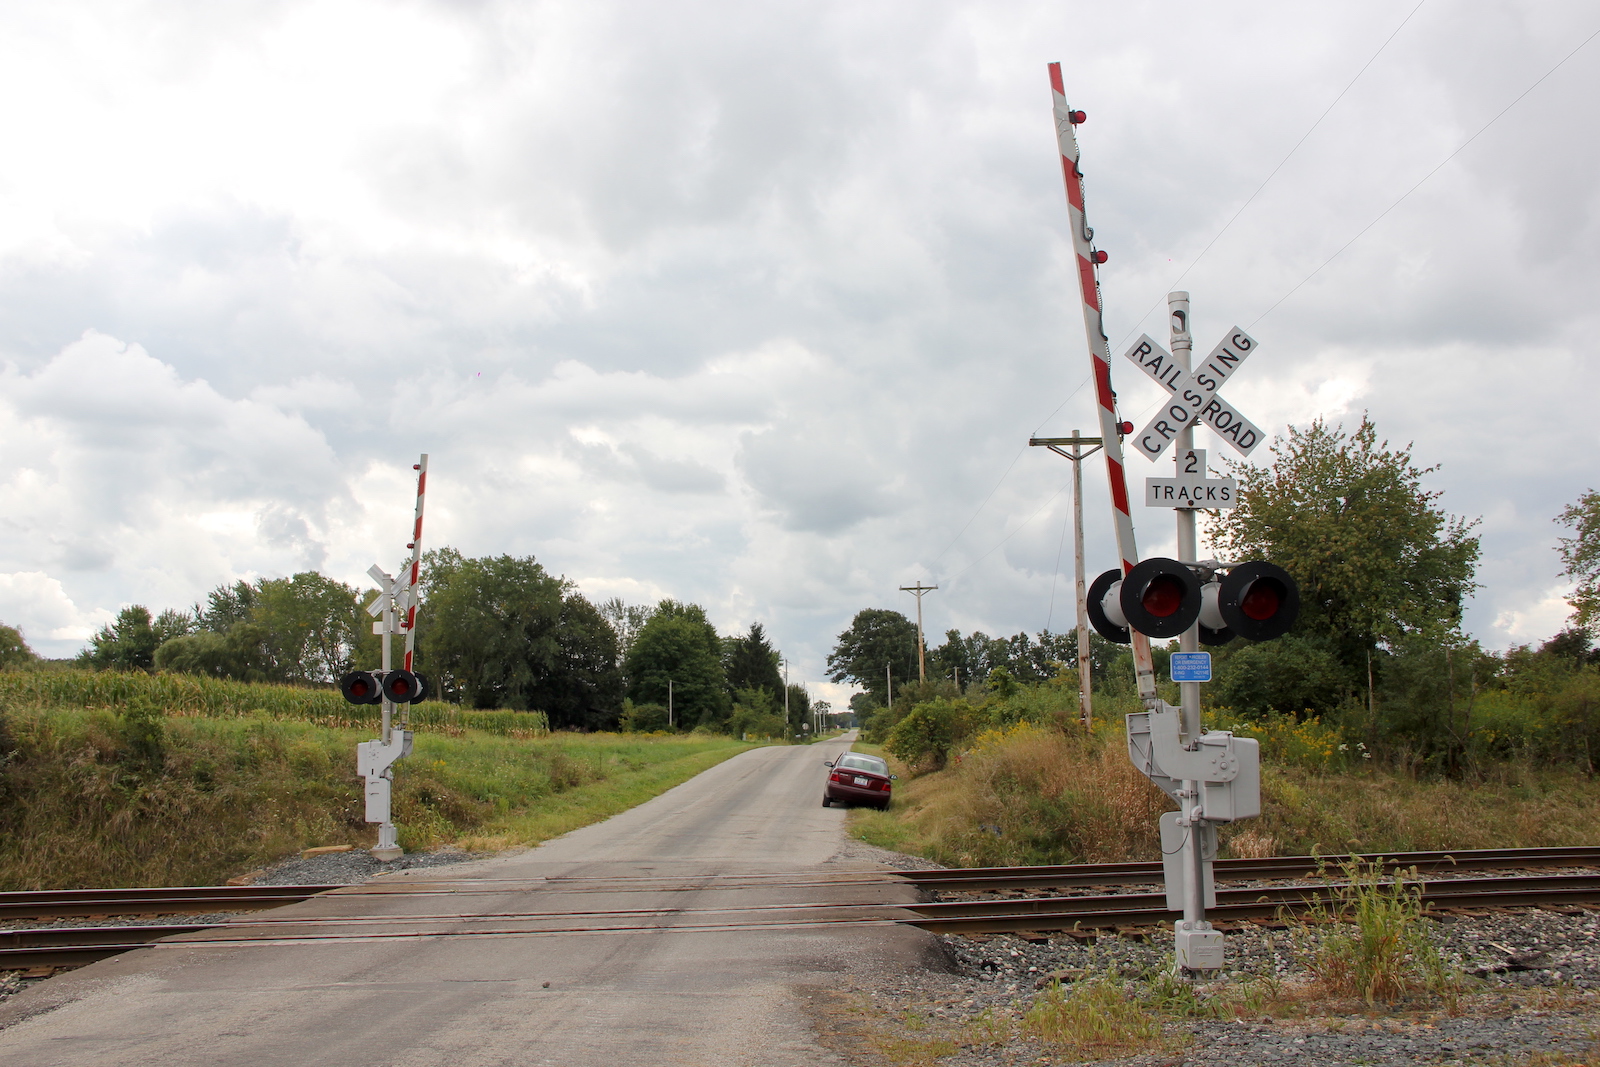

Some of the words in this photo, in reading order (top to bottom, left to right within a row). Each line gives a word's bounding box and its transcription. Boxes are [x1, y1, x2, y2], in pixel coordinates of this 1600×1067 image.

[1131, 341, 1181, 392] RAIL
[1201, 399, 1256, 449] ROAD
[1142, 333, 1251, 454] CROSSING
[1152, 485, 1230, 501] TRACKS
[1184, 455, 1198, 473] 2
